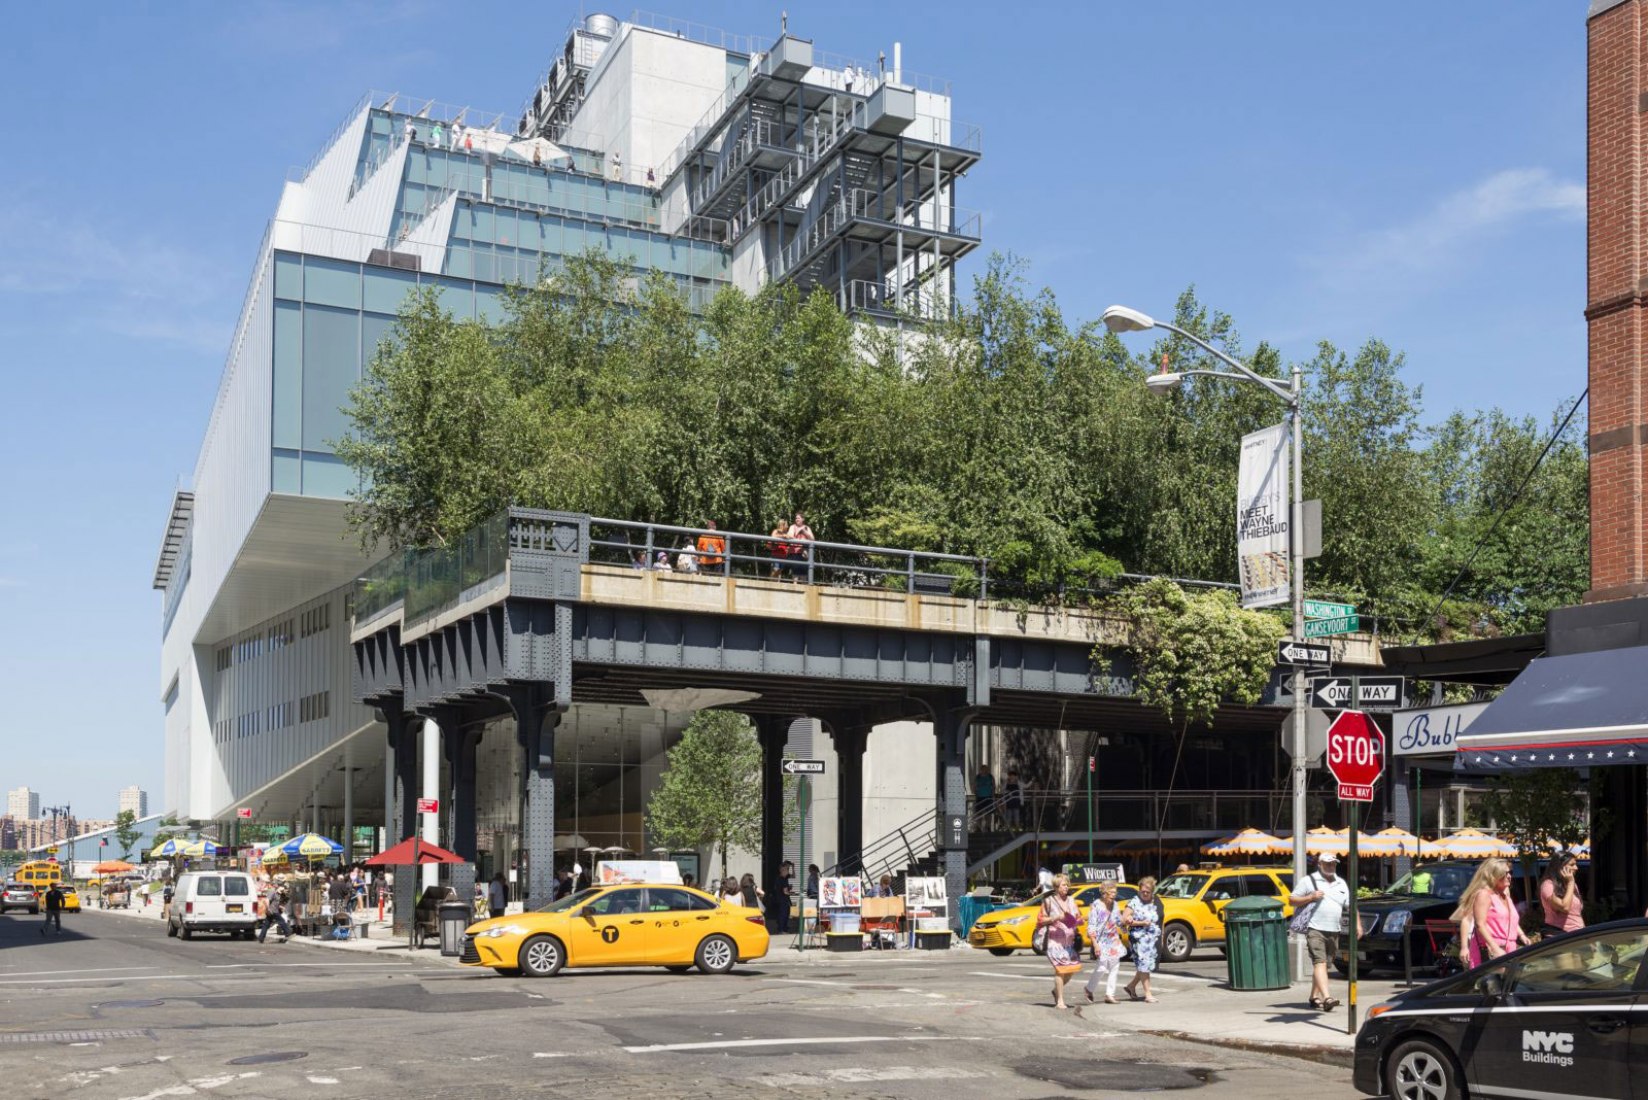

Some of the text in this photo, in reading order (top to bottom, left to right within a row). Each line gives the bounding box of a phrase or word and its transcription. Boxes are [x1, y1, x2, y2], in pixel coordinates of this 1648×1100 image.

[1240, 505, 1268, 519] MEET
[1240, 514, 1274, 530] WAYNE
[1240, 522, 1288, 540] THIEBAUD
[1305, 602, 1346, 617] WASHINGTON
[1305, 618, 1349, 636] GANSEVOORT
[1287, 648, 1324, 659] ONE WAY
[1362, 687, 1390, 699] WAY
[1331, 734, 1381, 766] STOP
[1340, 786, 1370, 797] ALL WAY
[605, 928, 616, 942] T
[1522, 1030, 1574, 1053] NYC
[1522, 1051, 1574, 1067] Buildings
